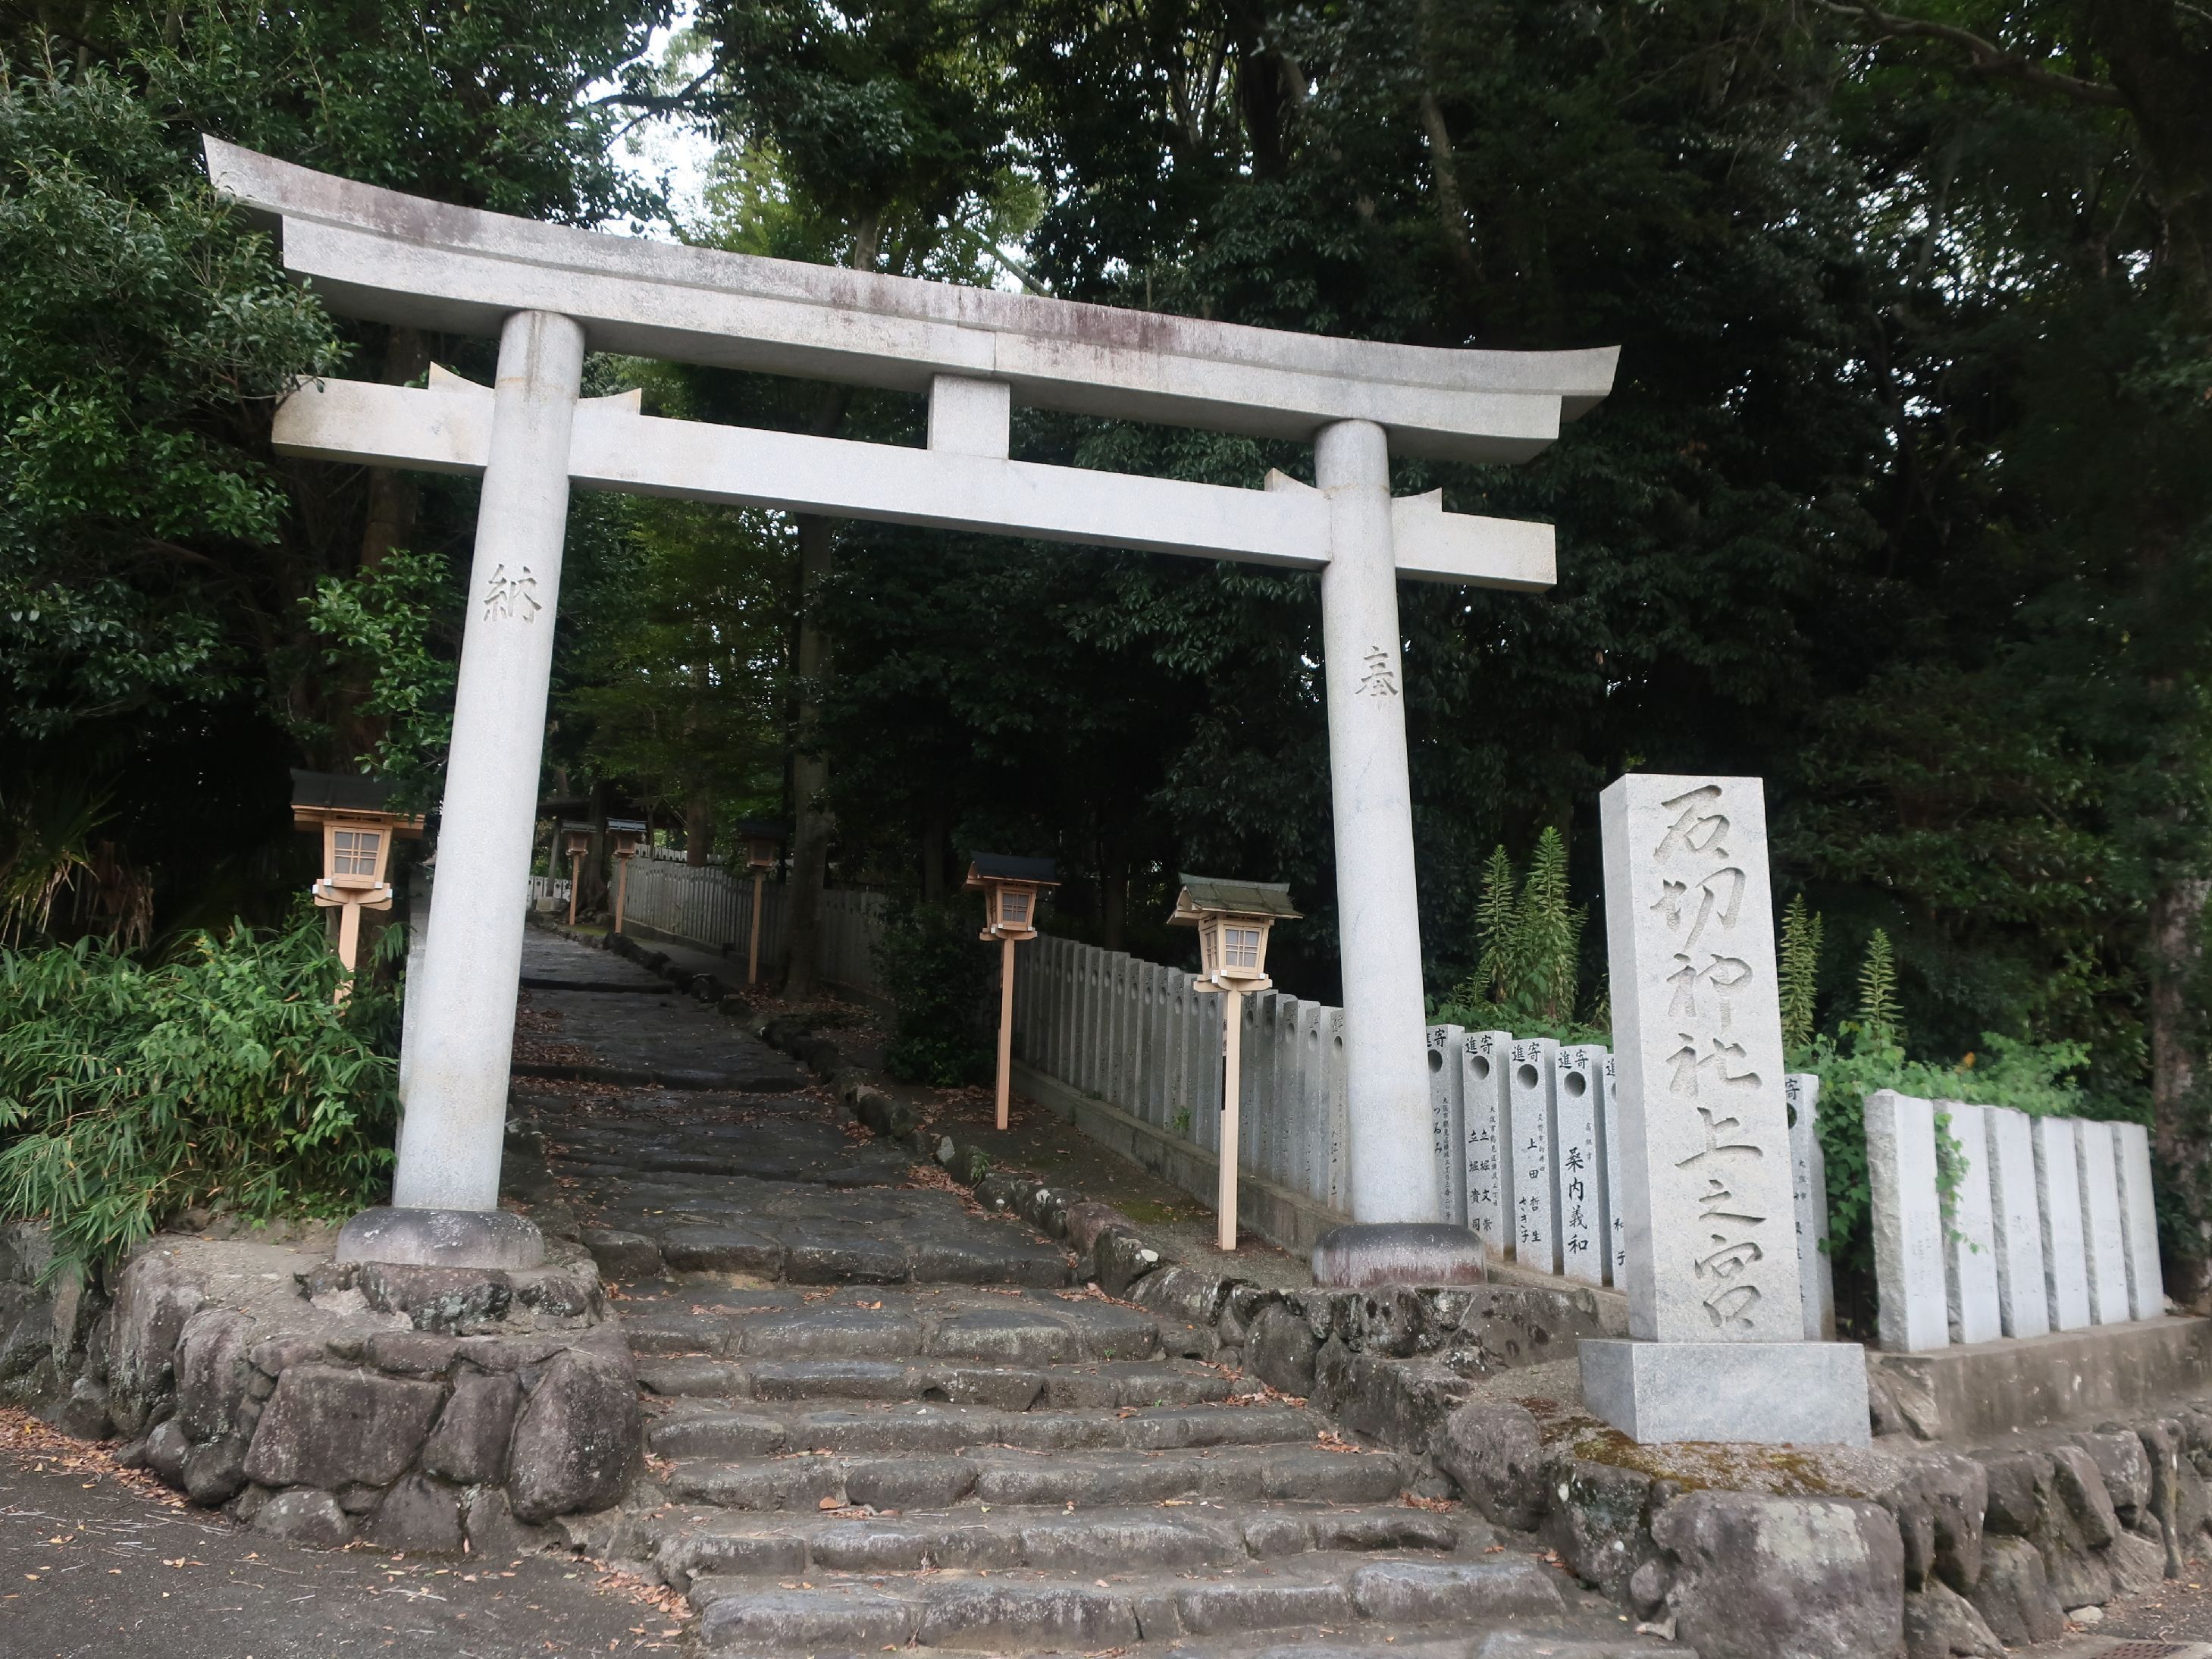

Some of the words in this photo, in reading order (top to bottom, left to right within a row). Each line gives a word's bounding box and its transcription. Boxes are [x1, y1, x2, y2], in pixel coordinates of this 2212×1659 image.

[483, 563, 543, 624] 納
[1355, 645, 1399, 711] 奉
[1650, 784, 1767, 1328] 石切神社上之宮
